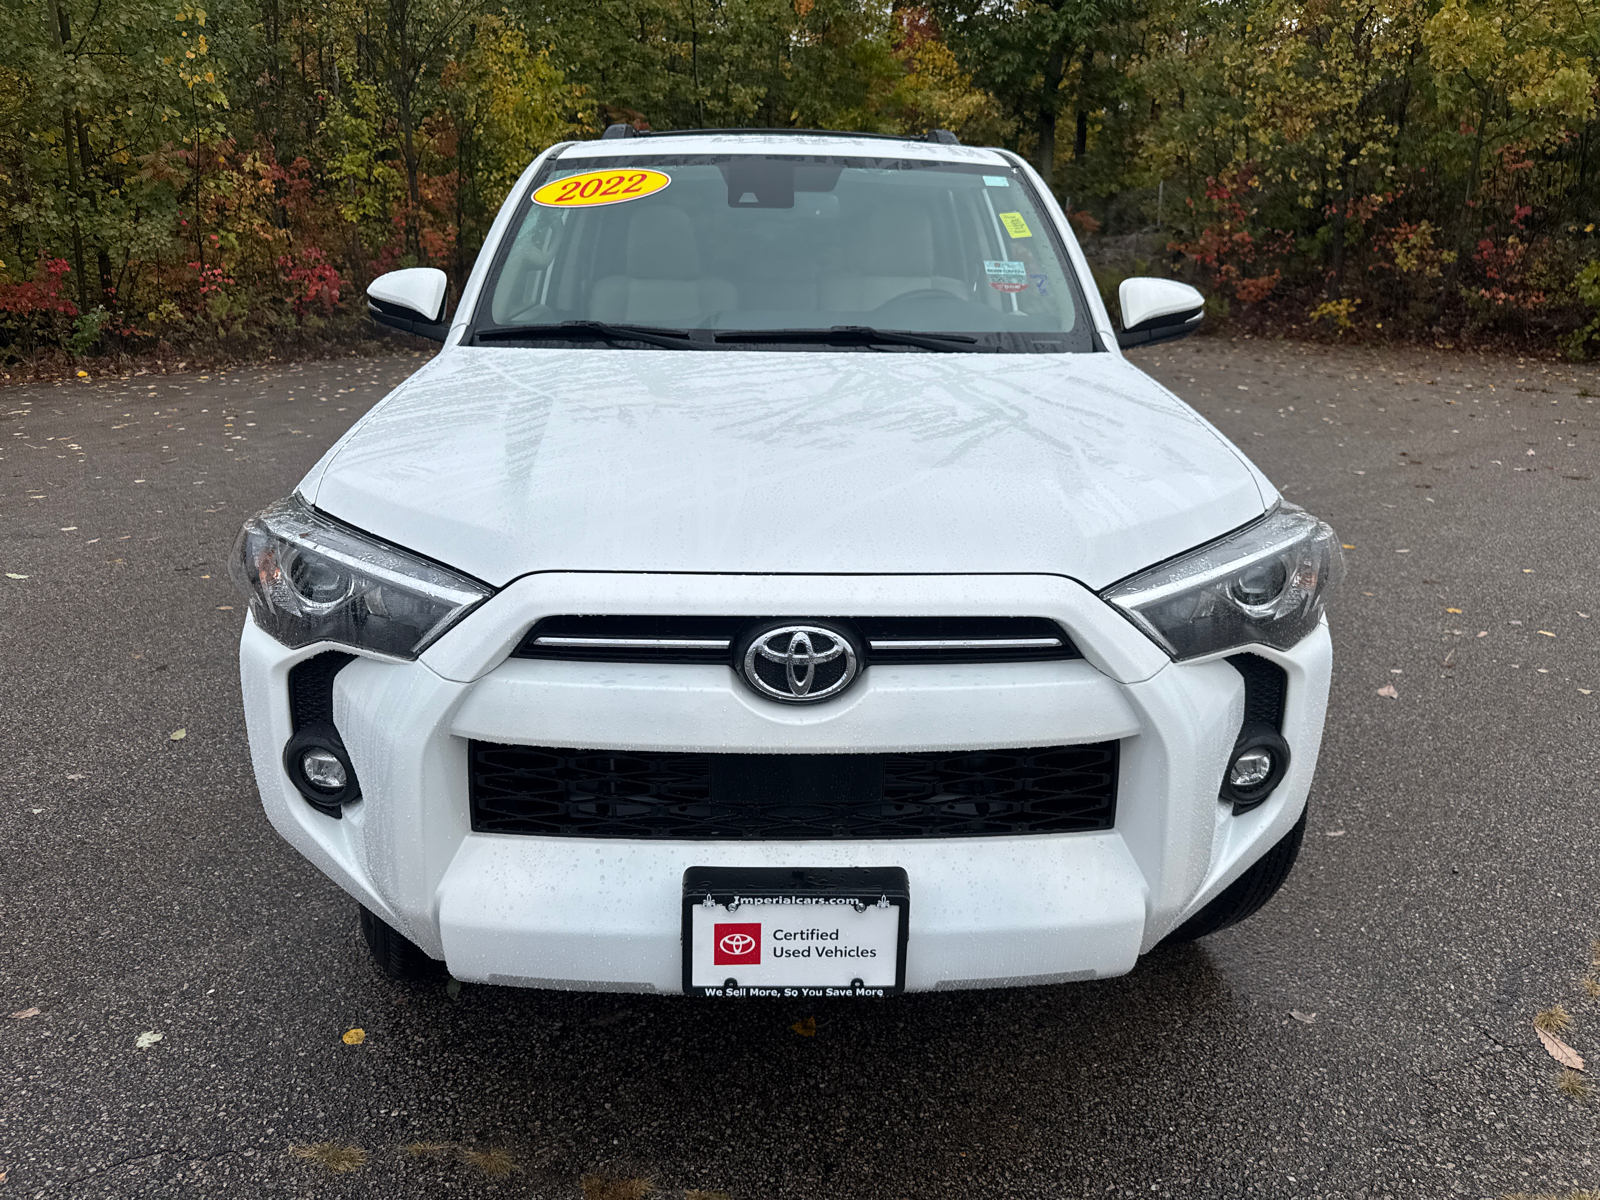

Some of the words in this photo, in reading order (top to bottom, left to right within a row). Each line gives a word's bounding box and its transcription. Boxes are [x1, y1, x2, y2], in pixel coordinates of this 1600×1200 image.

[554, 173, 648, 202] 2022
[733, 895, 860, 906] Imperialcars.com
[773, 928, 839, 941] Certified
[773, 946, 811, 958] Used
[814, 946, 877, 958] Vehicles
[705, 988, 723, 997] We
[723, 988, 747, 997] Sell
[749, 988, 781, 998] More,
[784, 988, 798, 997] So
[801, 988, 823, 997] You
[825, 988, 853, 997] Save
[855, 988, 884, 997] More
